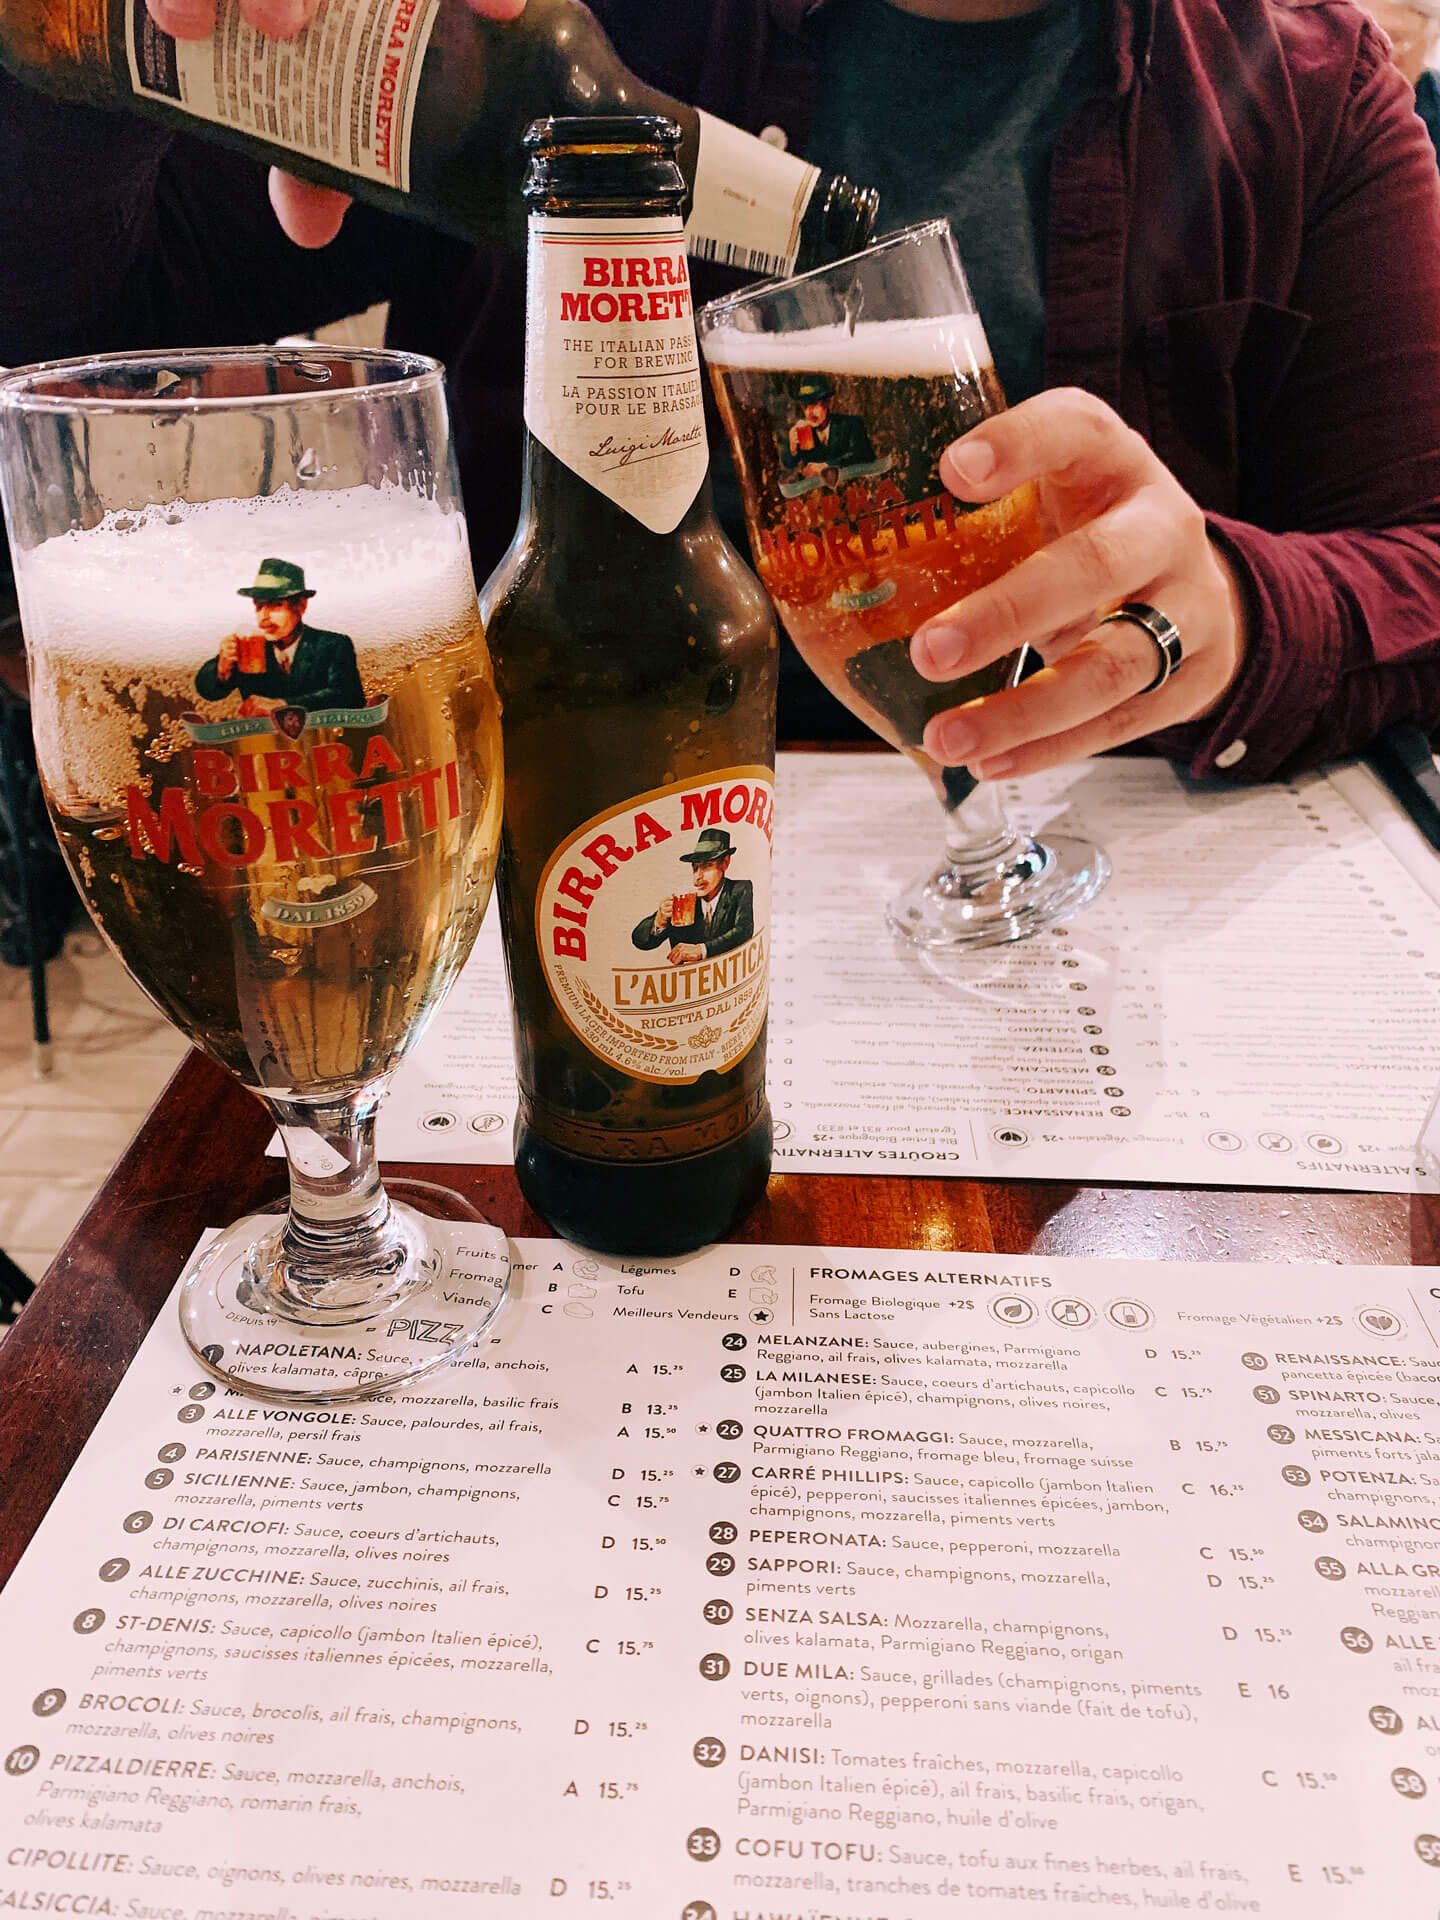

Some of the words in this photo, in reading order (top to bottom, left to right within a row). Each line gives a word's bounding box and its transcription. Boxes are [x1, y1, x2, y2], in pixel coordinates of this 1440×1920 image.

[375, 54, 401, 177] MORETTI
[584, 255, 687, 287] BIRRA
[564, 339, 593, 352] THE
[601, 339, 664, 352] ITALIAN
[594, 357, 627, 368] FOR
[562, 385, 580, 398] LA
[587, 386, 656, 399] PASSION
[576, 403, 620, 415] POUR
[627, 403, 646, 415] LE
[193, 735, 403, 797] BIRRA
[126, 761, 466, 866] MORETTI
[553, 812, 672, 961] BIRRA
[275, 906, 320, 923] DAL
[614, 940, 764, 1005] L'AUTENTICA
[554, 964, 582, 1009] PREMIUM
[579, 1009, 607, 1038] LAGER
[607, 1035, 657, 1062] IMPORTED
[660, 1055, 688, 1065] FROM
[689, 1049, 715, 1064] ITALY
[641, 1010, 704, 1029] RICETTA
[706, 1001, 731, 1019] DAL
[582, 1026, 600, 1043] 330
[878, 1151, 959, 1160] CROÛTES
[1297, 1161, 1410, 1176] ALTERNATIFS
[456, 1247, 496, 1259] Fruits
[553, 1263, 563, 1271] A
[621, 1265, 676, 1277] Légumes
[730, 1268, 740, 1276] D
[811, 1268, 918, 1281] FROMAGES
[924, 1272, 1051, 1287] ALTERNATIFS
[548, 1283, 557, 1292] B
[618, 1285, 644, 1295] Tofu
[729, 1289, 736, 1298] E
[542, 1305, 552, 1313] C
[810, 1294, 866, 1309] Fromage
[872, 1297, 940, 1311] Biologique
[613, 1307, 672, 1318] Meilleurs
[678, 1309, 739, 1320] Vendeurs
[810, 1308, 840, 1318] Sans
[845, 1309, 894, 1320] Lactose
[1177, 1312, 1237, 1326] Fromage
[236, 1344, 362, 1360] NAPOLETANA:
[726, 1337, 743, 1347] 24
[758, 1335, 868, 1347] MELANZANE:
[873, 1338, 917, 1351] Sauce,
[923, 1340, 999, 1355] aubergines,
[1004, 1344, 1080, 1359] Parmigiano
[1145, 1349, 1157, 1358] D
[495, 1360, 548, 1372] anchois,
[1275, 1353, 1406, 1366] RENAISSANCE:
[272, 1363, 338, 1378] kalamata,
[626, 1364, 638, 1373] A
[654, 1365, 683, 1375] 15.25
[725, 1369, 742, 1378] 25
[757, 1371, 777, 1381] LA
[782, 1372, 876, 1384] MILANESE:
[881, 1375, 927, 1388] Sauce,
[1155, 1387, 1167, 1397] C
[1289, 1390, 1385, 1403] SPINARTO:
[483, 1396, 525, 1407] basilic
[530, 1397, 558, 1409] frais
[622, 1403, 631, 1413] B
[755, 1404, 827, 1415] mozzarella
[213, 1409, 258, 1420] ALLE
[263, 1410, 356, 1424] VONGOLE:
[360, 1414, 406, 1428] Sauce,
[411, 1417, 483, 1431] palourdes,
[489, 1420, 504, 1430] ail
[509, 1420, 542, 1434] frais,
[206, 1427, 283, 1440] mozzarella,
[287, 1429, 328, 1442] persil
[332, 1430, 360, 1441] frais
[617, 1427, 629, 1437] A
[645, 1428, 676, 1438] 15.50
[720, 1425, 739, 1435] 26
[754, 1425, 841, 1439] QUATTRO
[848, 1429, 953, 1443] FROMAGGI:
[1305, 1429, 1421, 1443] MESSICANA:
[1170, 1440, 1181, 1450] B
[196, 1448, 312, 1464] PARISIENNE:
[317, 1454, 363, 1468] Sauce,
[369, 1456, 469, 1474] champignons,
[475, 1463, 551, 1474] mozzarella
[612, 1469, 624, 1479] D
[641, 1470, 673, 1481] 15.25
[718, 1467, 737, 1478] 27
[752, 1466, 815, 1480] CARRÉ
[822, 1469, 908, 1484] PHILLIPS:
[1320, 1470, 1416, 1485] POTENZA:
[184, 1473, 295, 1488] SICILIENNE:
[300, 1478, 347, 1494] Sauce,
[351, 1481, 411, 1496] jambon,
[1182, 1483, 1195, 1494] C
[163, 1517, 185, 1529] DI
[190, 1519, 289, 1535] CARCIOFI:
[713, 1527, 733, 1539] 28
[750, 1530, 886, 1547] PEPERONATA:
[892, 1536, 943, 1552] Sauce,
[949, 1541, 1033, 1556] pepperoni,
[1038, 1544, 1120, 1556] mozzarella
[1200, 1547, 1213, 1559] C
[710, 1558, 731, 1571] 29
[748, 1558, 840, 1574] SAPPORI:
[139, 1565, 190, 1579] ALLE
[192, 1567, 304, 1584] ZUCCHINE:
[706, 1606, 730, 1619] 30
[746, 1608, 813, 1623] SENZA
[819, 1611, 888, 1626] SALSA:
[116, 1616, 215, 1633] ST-DENIS:
[586, 1639, 600, 1653] C
[618, 1641, 653, 1655] 15.75
[705, 1660, 723, 1674] 31
[744, 1661, 788, 1677] DUE
[795, 1664, 854, 1680] MILA:
[1238, 1682, 1251, 1698] E
[1268, 1684, 1290, 1699] 16
[79, 1694, 184, 1713] BROCOLI:
[698, 1744, 721, 1761] 32
[741, 1745, 824, 1764] DANISI:
[50, 1754, 216, 1779] PIZZALDIERRE:
[691, 1836, 716, 1854] 33
[736, 1838, 803, 1859] COFU
[811, 1841, 882, 1862] TOFU:
[7, 1848, 133, 1873] CIPOLLITE:
